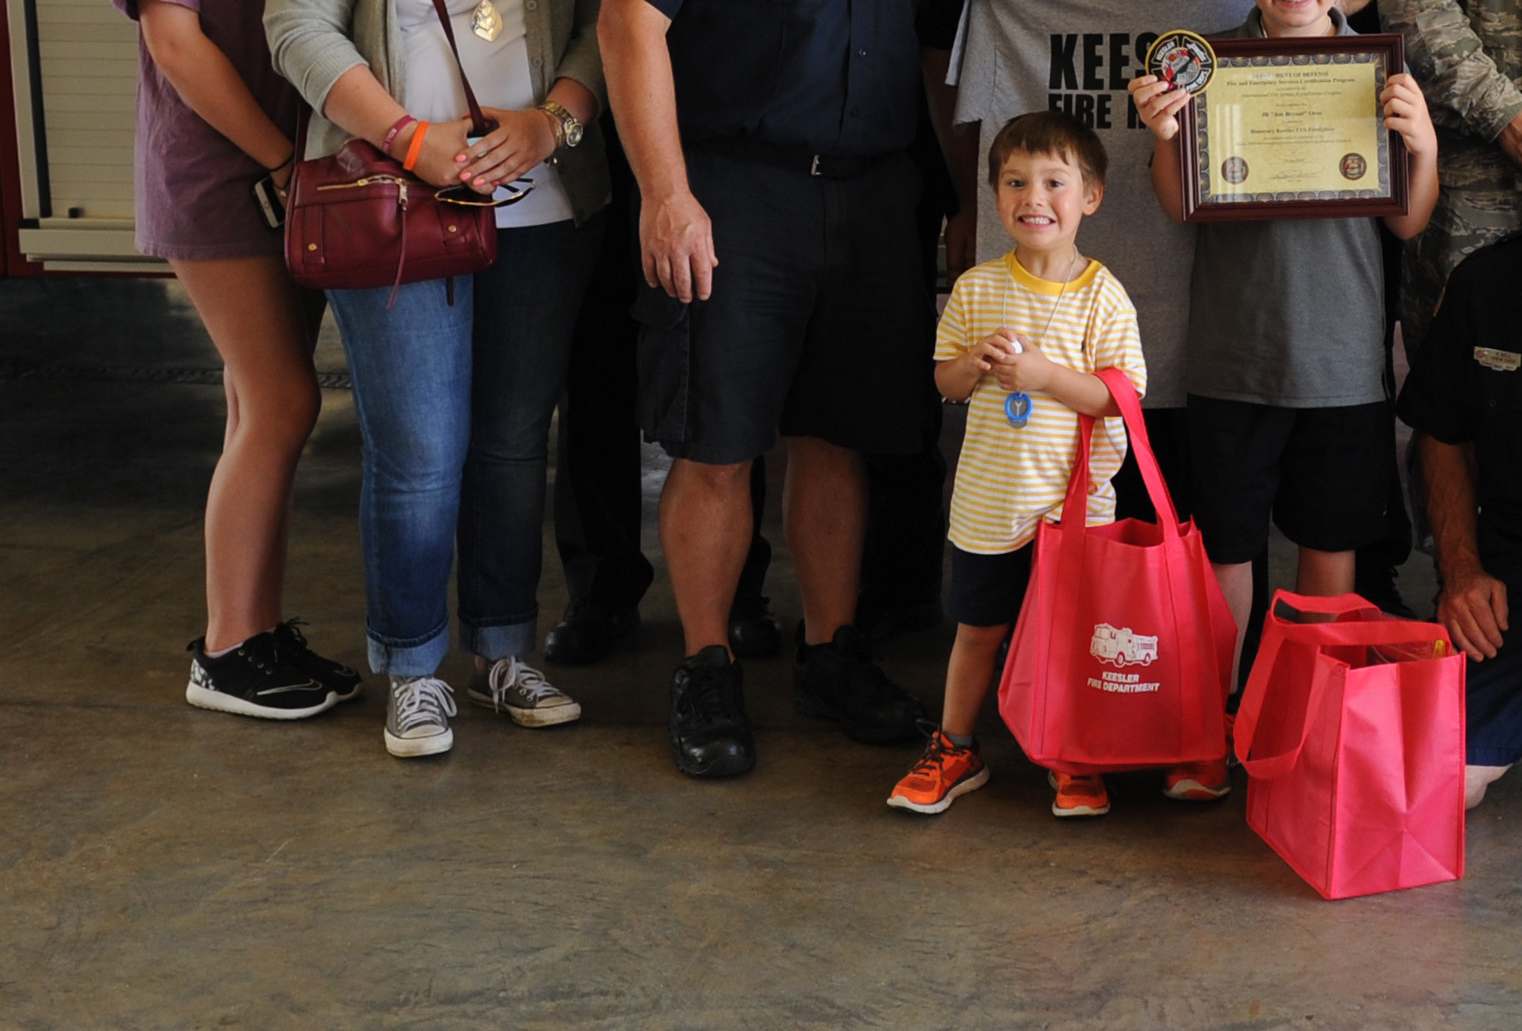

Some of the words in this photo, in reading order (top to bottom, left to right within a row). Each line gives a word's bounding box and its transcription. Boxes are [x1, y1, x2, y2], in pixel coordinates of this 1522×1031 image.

[1102, 671, 1140, 683] KEESLER
[1087, 677, 1102, 690] FIRE
[1102, 681, 1161, 693] DEPARTMENT
